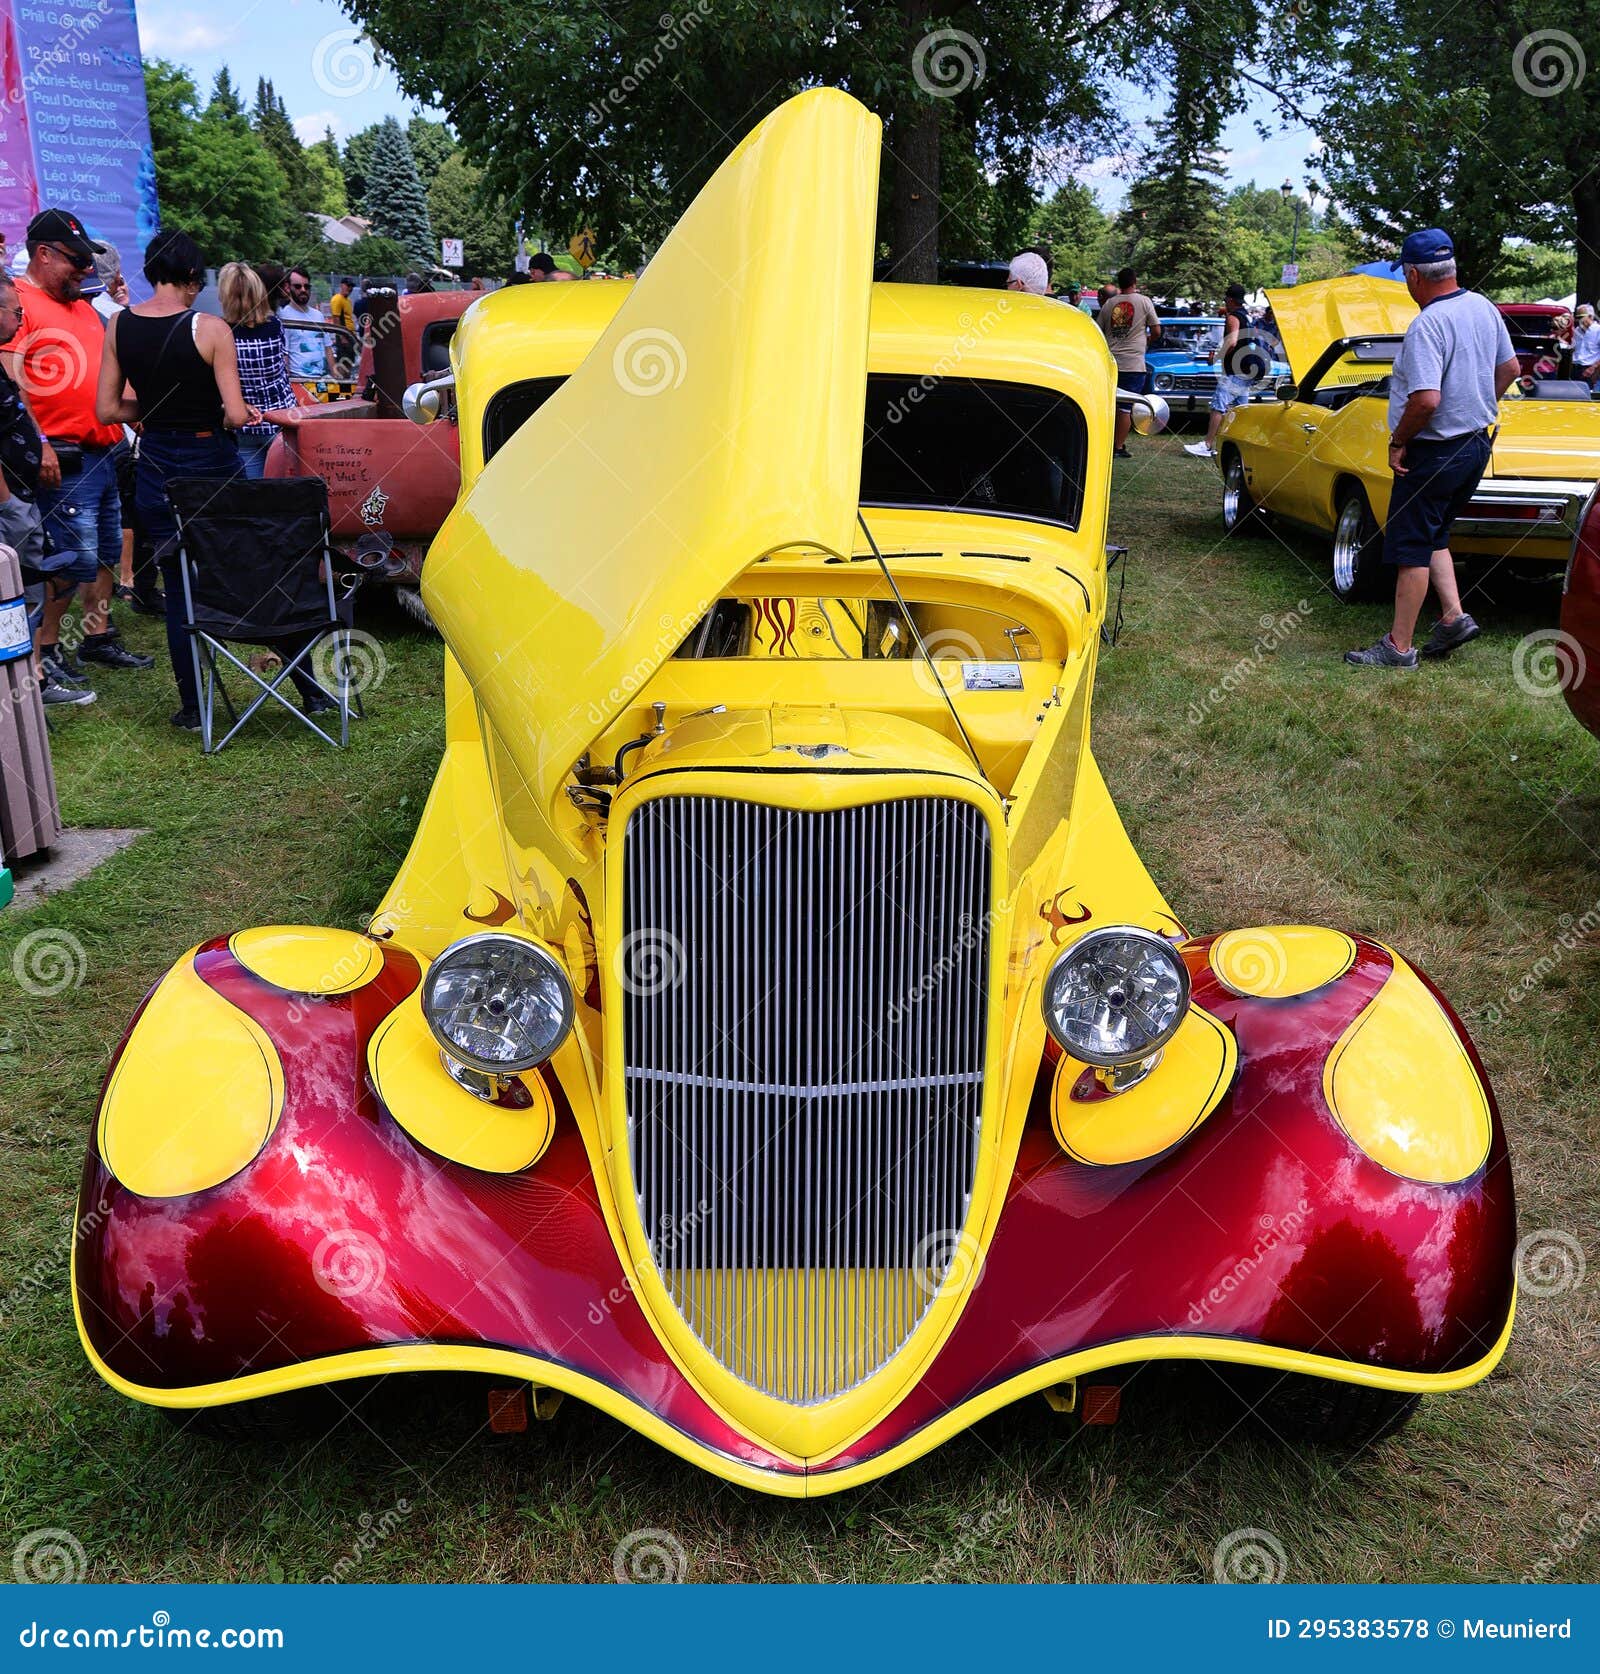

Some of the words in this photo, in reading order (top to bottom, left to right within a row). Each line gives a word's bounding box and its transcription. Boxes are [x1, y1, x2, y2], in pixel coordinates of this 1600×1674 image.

[20, 8, 45, 22] Phil
[27, 46, 41, 59] 12
[76, 52, 91, 65] 19
[93, 54, 101, 66] h
[95, 79, 130, 94] Laure
[32, 91, 60, 104] Paul
[35, 111, 71, 129] Cindy
[73, 114, 118, 129] Bédard
[38, 130, 68, 145] Karo
[41, 149, 75, 164] Steve
[78, 153, 123, 168] Veilleux
[43, 169, 67, 182] Léa
[70, 172, 101, 188] Jarry
[46, 187, 69, 201] Phil
[71, 189, 85, 201] G.
[87, 191, 121, 204] Smith
